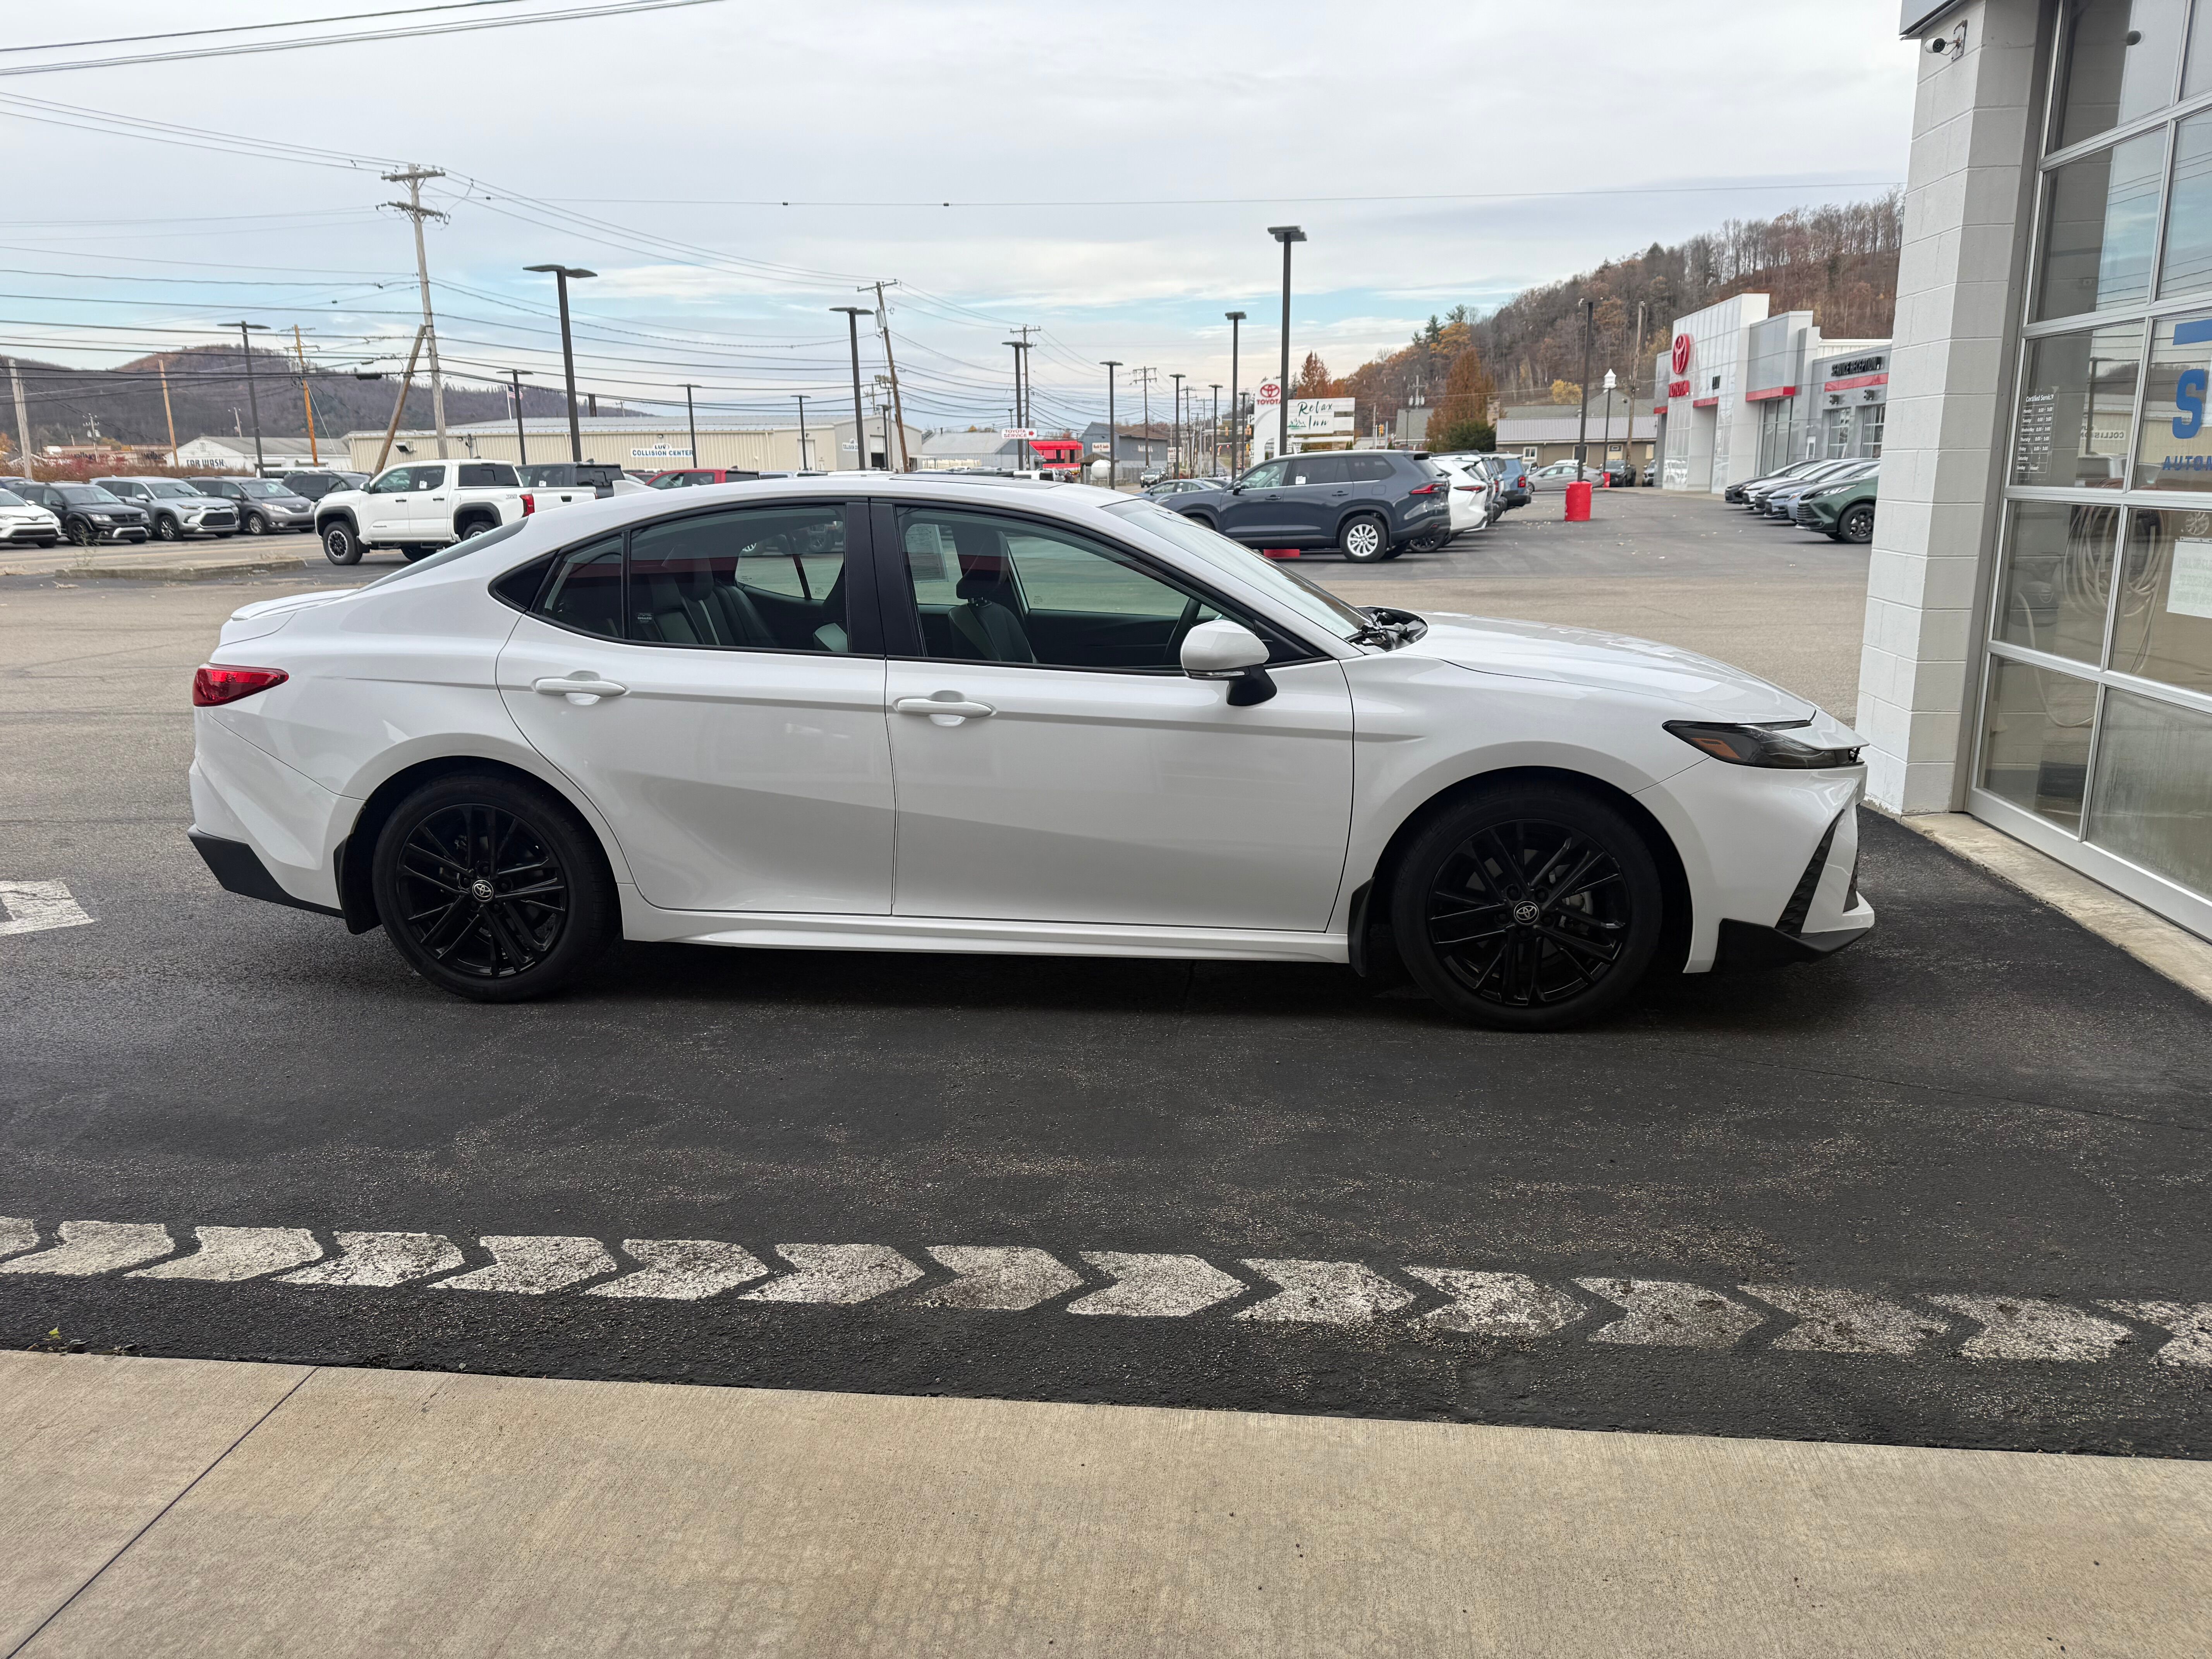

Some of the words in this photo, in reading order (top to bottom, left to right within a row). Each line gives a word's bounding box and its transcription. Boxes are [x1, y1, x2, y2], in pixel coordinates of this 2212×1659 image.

[1669, 380, 1690, 398] TOYOTA
[1298, 401, 1333, 417] Relax
[1309, 415, 1327, 430] Inn
[202, 459, 224, 467] WASH
